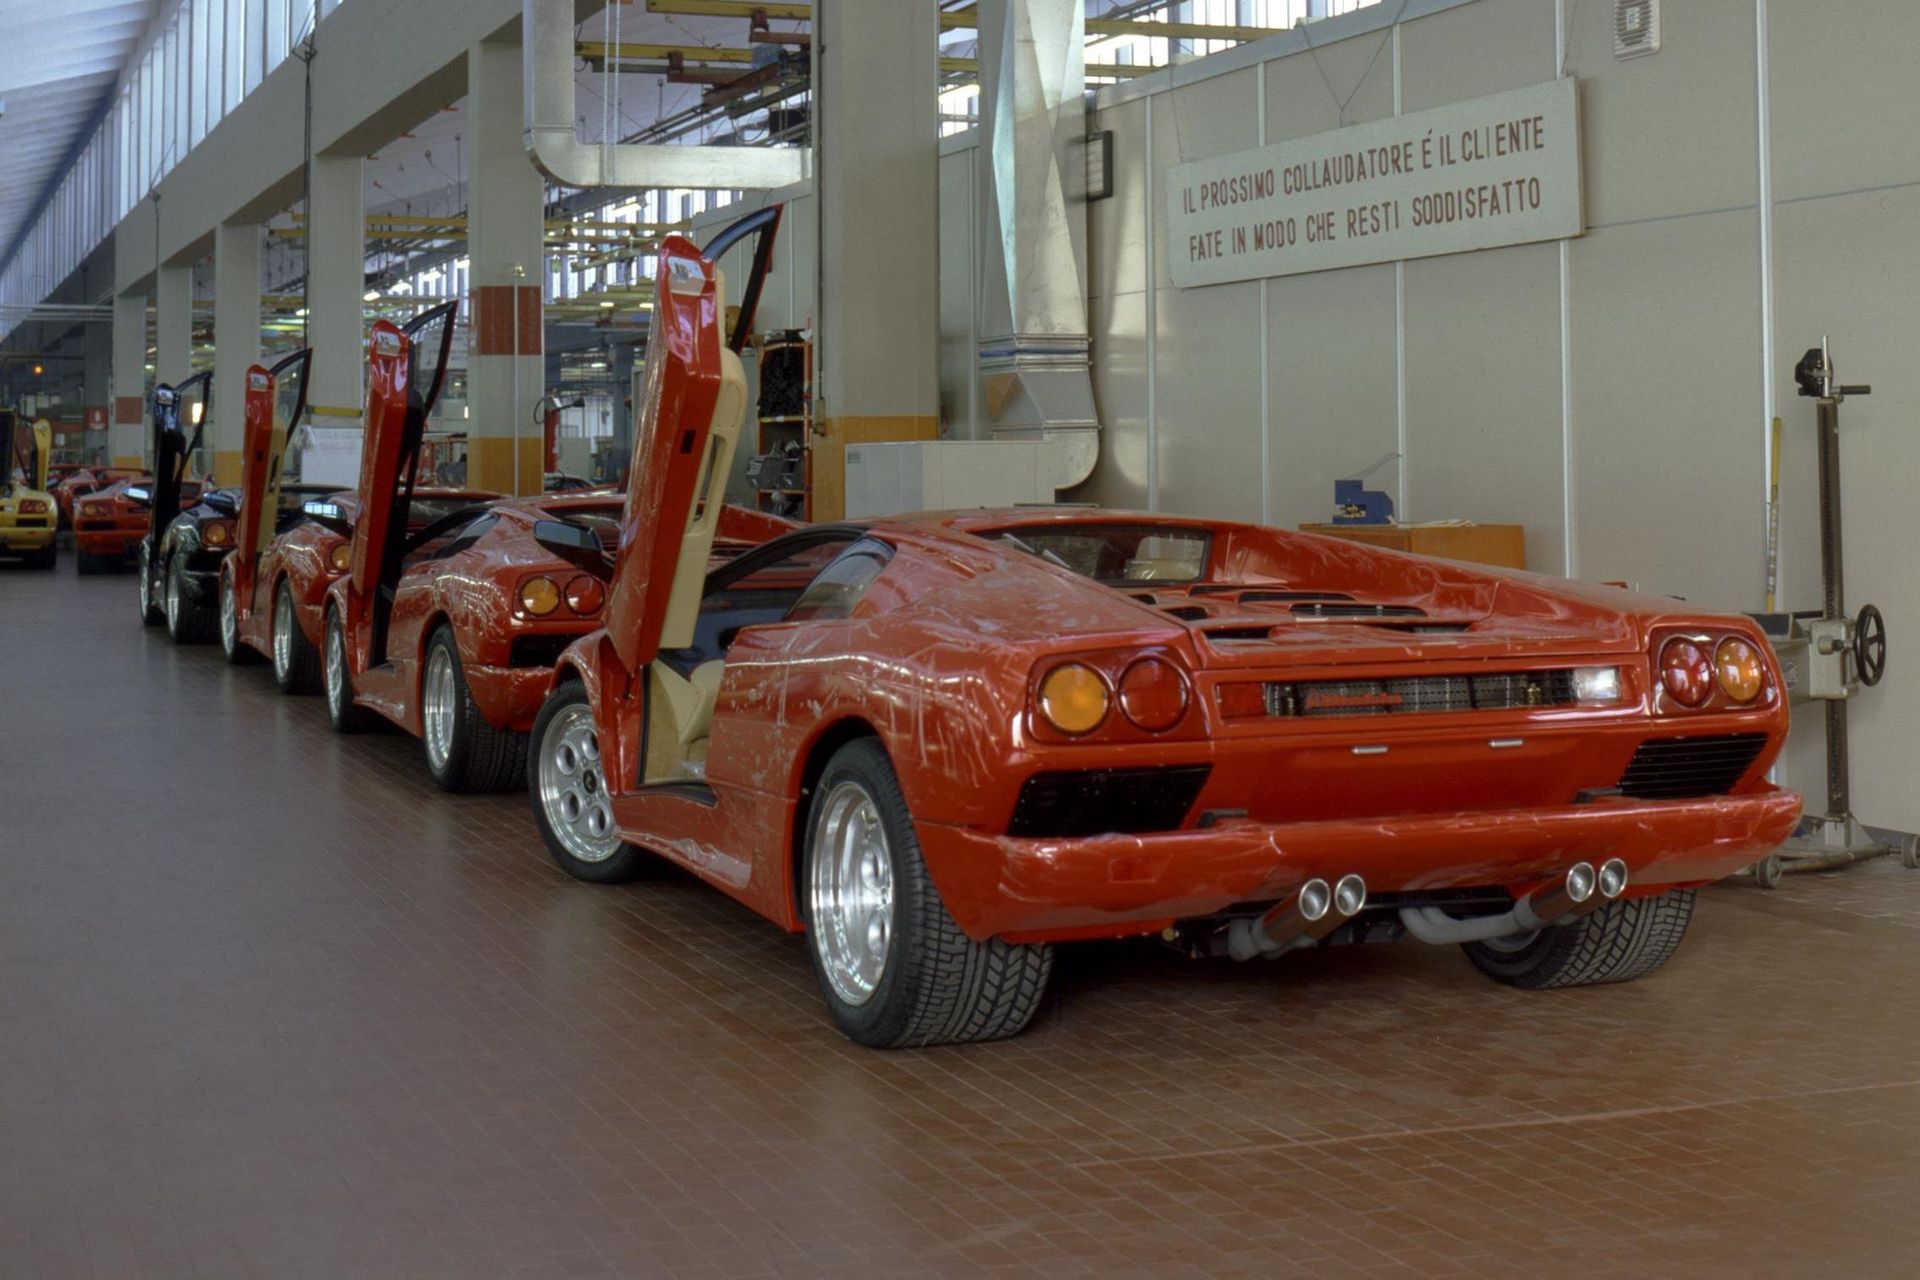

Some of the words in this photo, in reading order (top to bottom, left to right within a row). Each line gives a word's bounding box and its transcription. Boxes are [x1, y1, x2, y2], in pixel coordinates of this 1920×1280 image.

[1183, 187, 1196, 214] IL
[1200, 169, 1274, 209] PROSSIMO
[1283, 141, 1414, 195] COLLAUDATORE
[1421, 128, 1433, 169] É
[1439, 134, 1456, 167] IL
[1461, 115, 1544, 163] CLIENTE
[1189, 229, 1222, 262] FATE
[1231, 227, 1246, 254] IN
[1253, 217, 1296, 251] MODO
[1306, 211, 1335, 242] CHE
[1347, 200, 1400, 238] RESTI
[1412, 175, 1540, 227] SODDISFATTO
